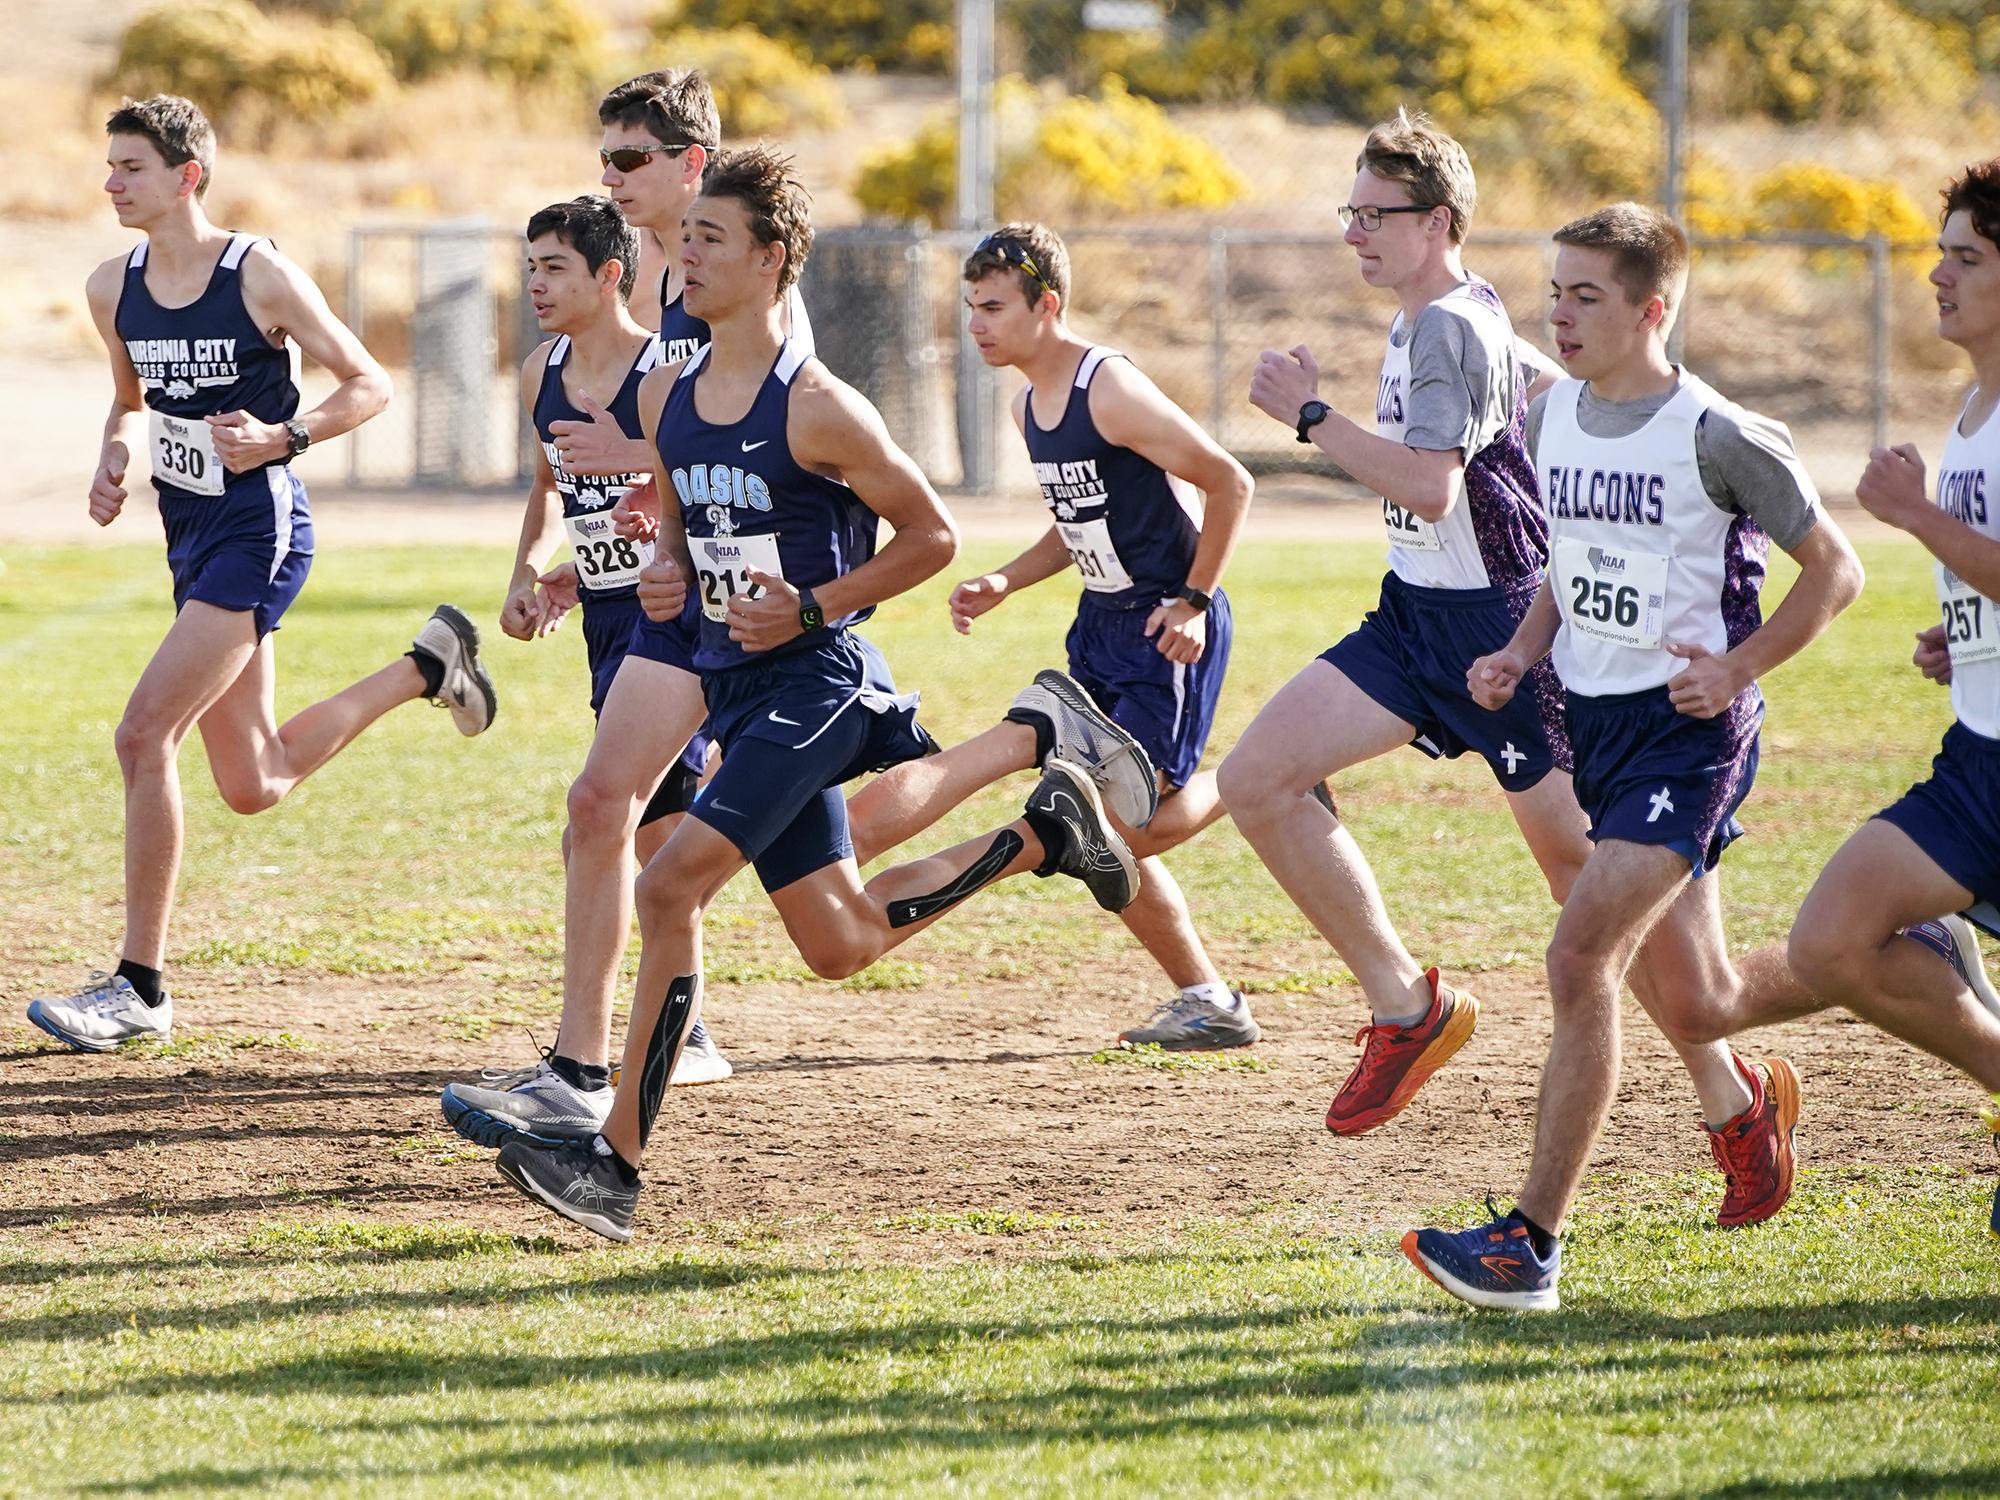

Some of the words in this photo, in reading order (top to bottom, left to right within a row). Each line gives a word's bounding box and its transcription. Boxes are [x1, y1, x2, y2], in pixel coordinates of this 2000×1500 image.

[126, 339, 191, 363] VIRGINIA
[194, 338, 237, 363] CITY
[668, 337, 699, 364] CITY
[171, 362, 238, 378] COUNTRY
[160, 437, 205, 479] 330
[1061, 459, 1098, 484] CITY
[672, 464, 774, 512] OASIS
[1053, 478, 1106, 498] COUNTRY
[1549, 466, 1666, 526] FALCONS
[576, 537, 640, 576] 328
[714, 546, 741, 557] NIAA
[1598, 554, 1626, 570] NIAA
[1571, 575, 1640, 628] 256
[1942, 595, 1982, 644] 257
[1586, 625, 1640, 645] Championships
[675, 994, 688, 1004] KT
